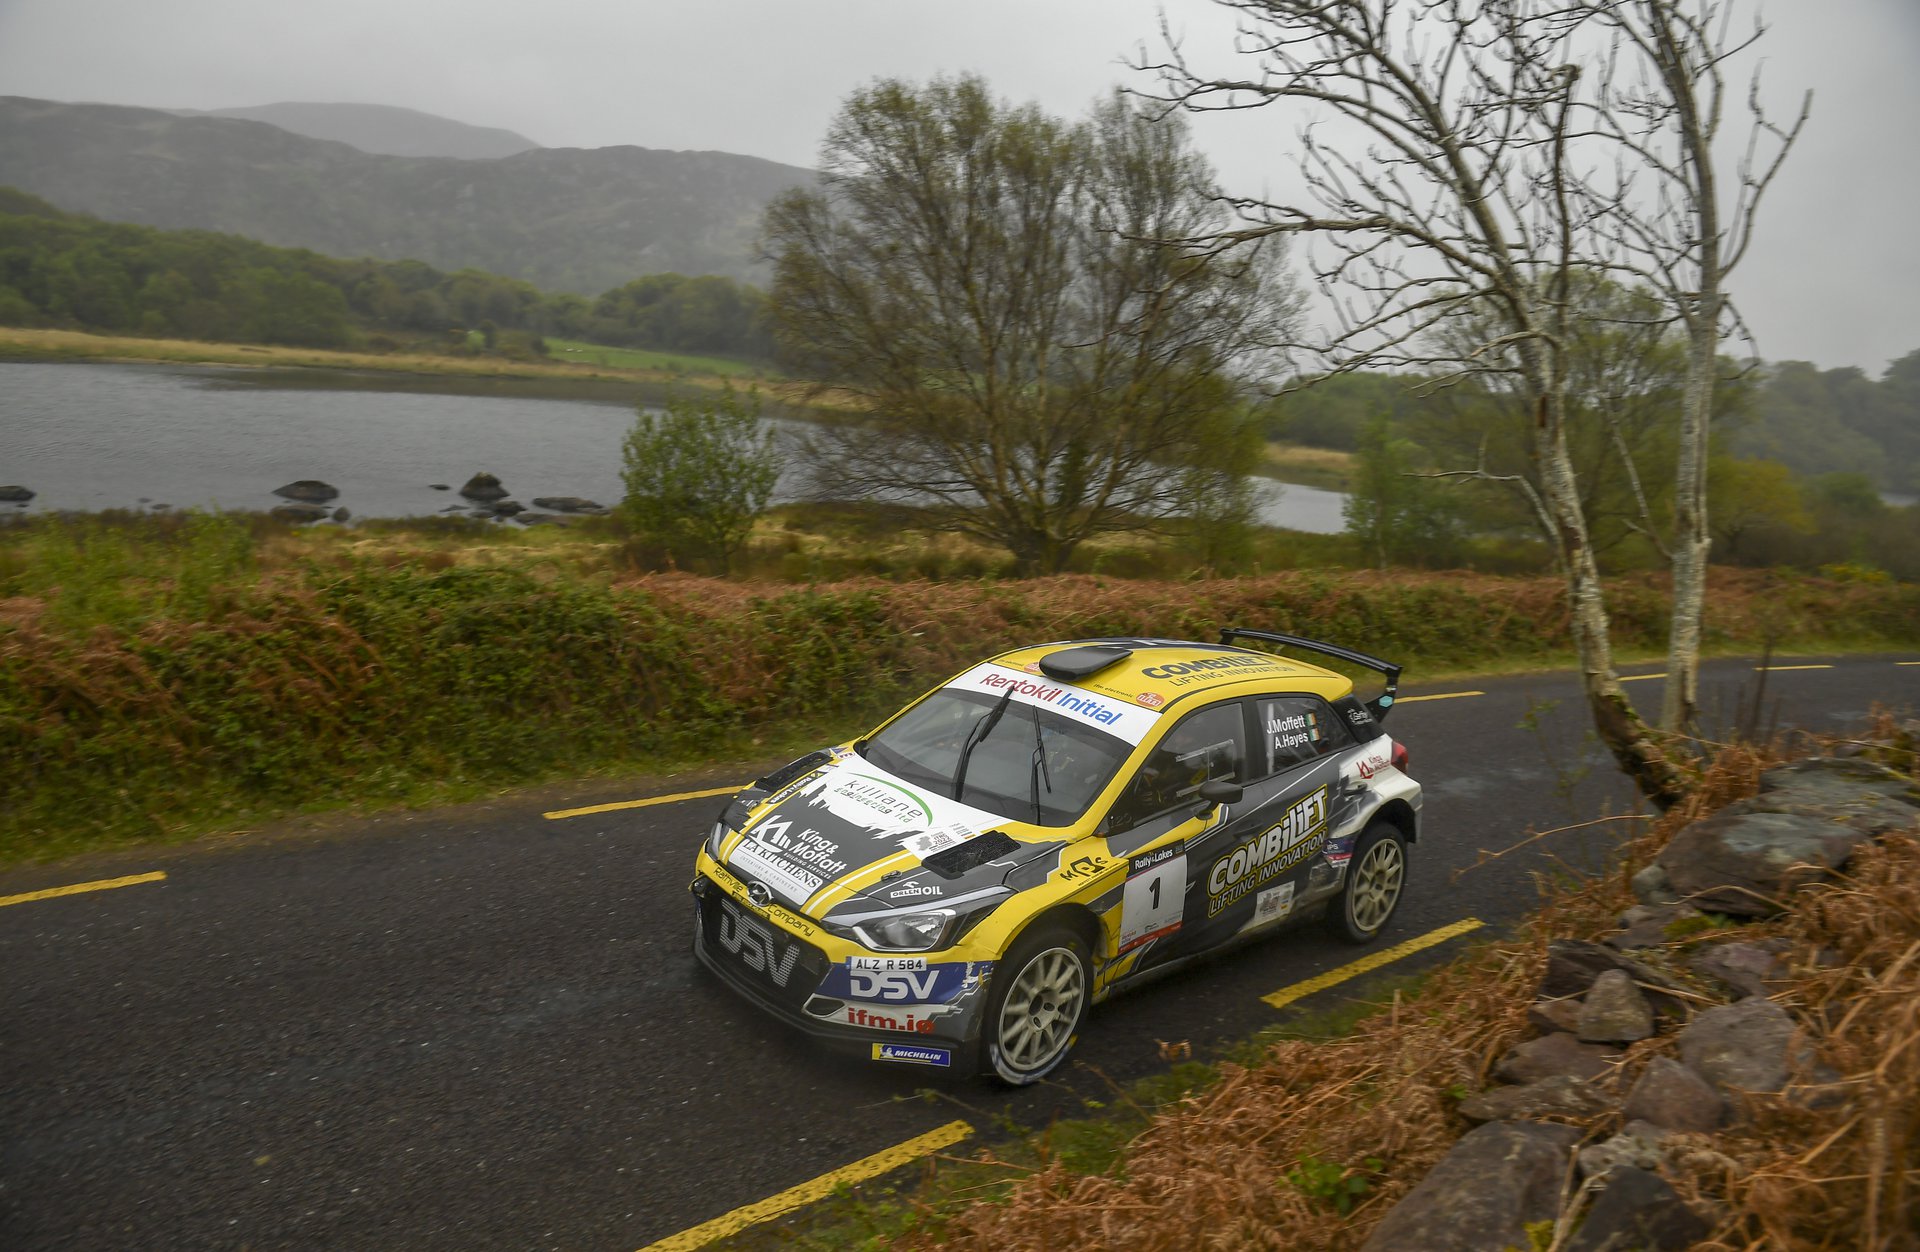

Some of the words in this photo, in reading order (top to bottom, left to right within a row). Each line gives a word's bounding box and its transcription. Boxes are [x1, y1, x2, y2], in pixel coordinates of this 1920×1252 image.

[979, 673, 1063, 703] Rentokil
[1055, 692, 1123, 726] Initial
[1266, 714, 1306, 735] J.Moffett
[1274, 732, 1309, 750] A.Hayes
[758, 846, 820, 888] KITCHENS
[788, 841, 848, 875] Moffatt
[806, 864, 832, 880] SERVICES
[1258, 829, 1328, 883] INNOVATION
[922, 885, 943, 896] OIL
[1148, 876, 1161, 910] 1
[766, 903, 815, 938] Company
[720, 898, 800, 987] DSV
[856, 959, 881, 970] ALZ
[886, 960, 895, 970] R
[898, 959, 923, 970] 584
[850, 970, 940, 1000] DSV
[894, 1050, 942, 1061] MICHELIN
